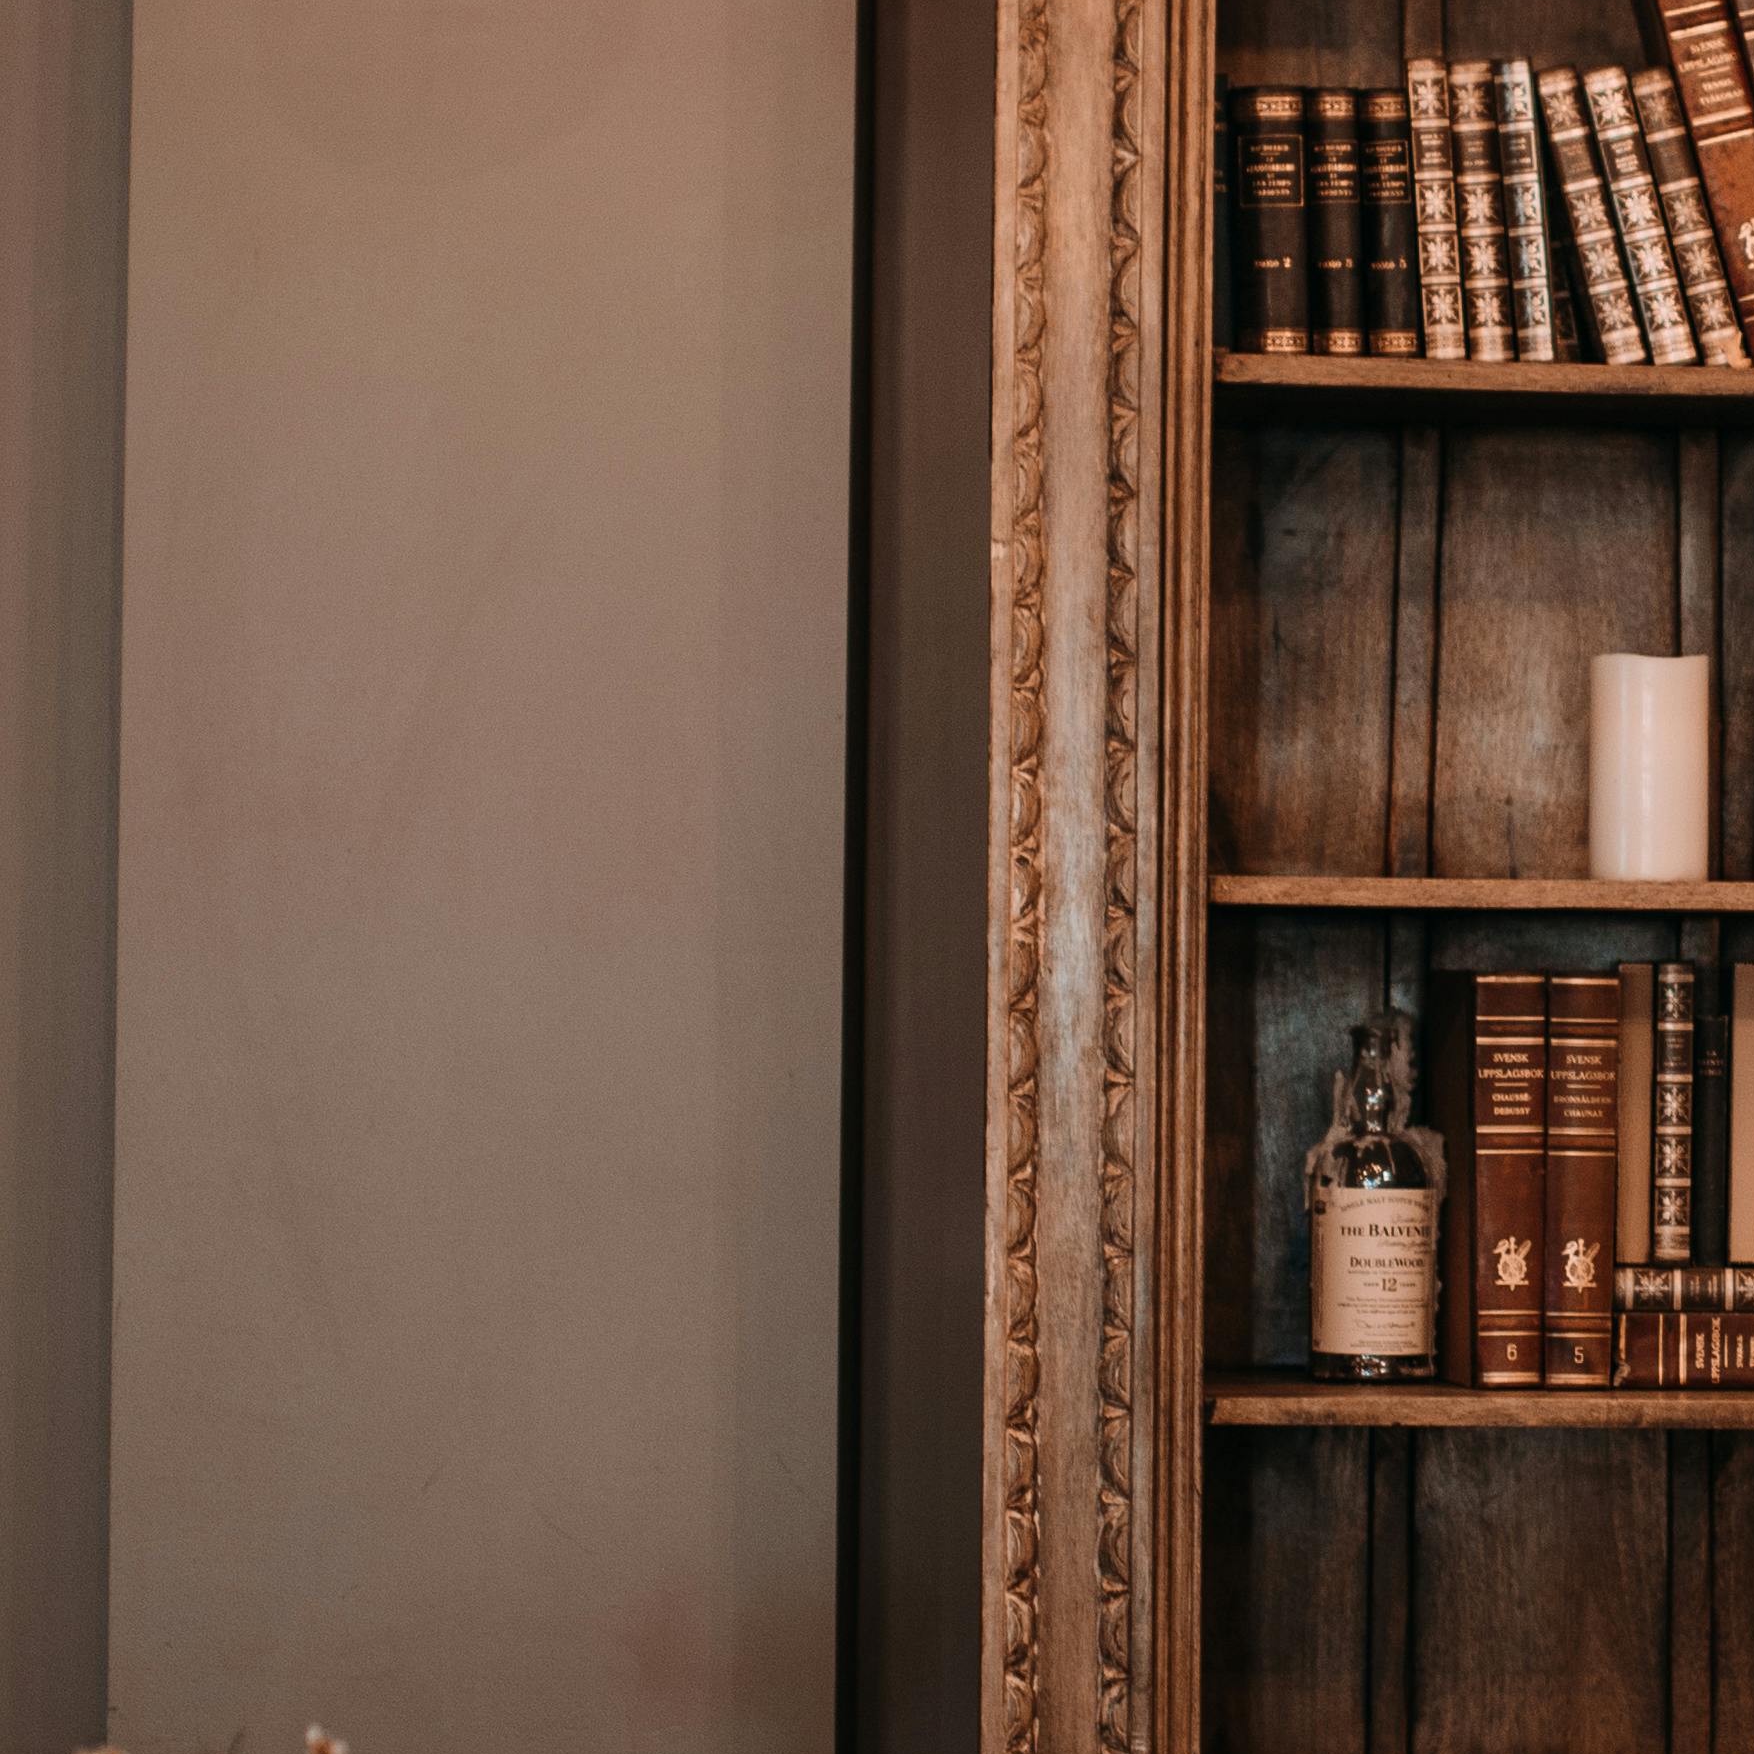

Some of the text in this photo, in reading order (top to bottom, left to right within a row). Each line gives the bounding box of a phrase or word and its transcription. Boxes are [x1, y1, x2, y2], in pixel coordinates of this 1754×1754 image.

[1493, 1052, 1530, 1064] SVENSK
[1566, 1054, 1603, 1066] SVENSK
[1478, 1068, 1544, 1080] UPPSLAGSBOK
[1550, 1070, 1617, 1082] UPPSLAGSBOK
[1340, 1225, 1363, 1237] THE
[1380, 1277, 1398, 1293] 12
[1506, 1342, 1518, 1362] 6
[1573, 1346, 1585, 1364] 5
[1695, 1333, 1705, 1369] SVENSK
